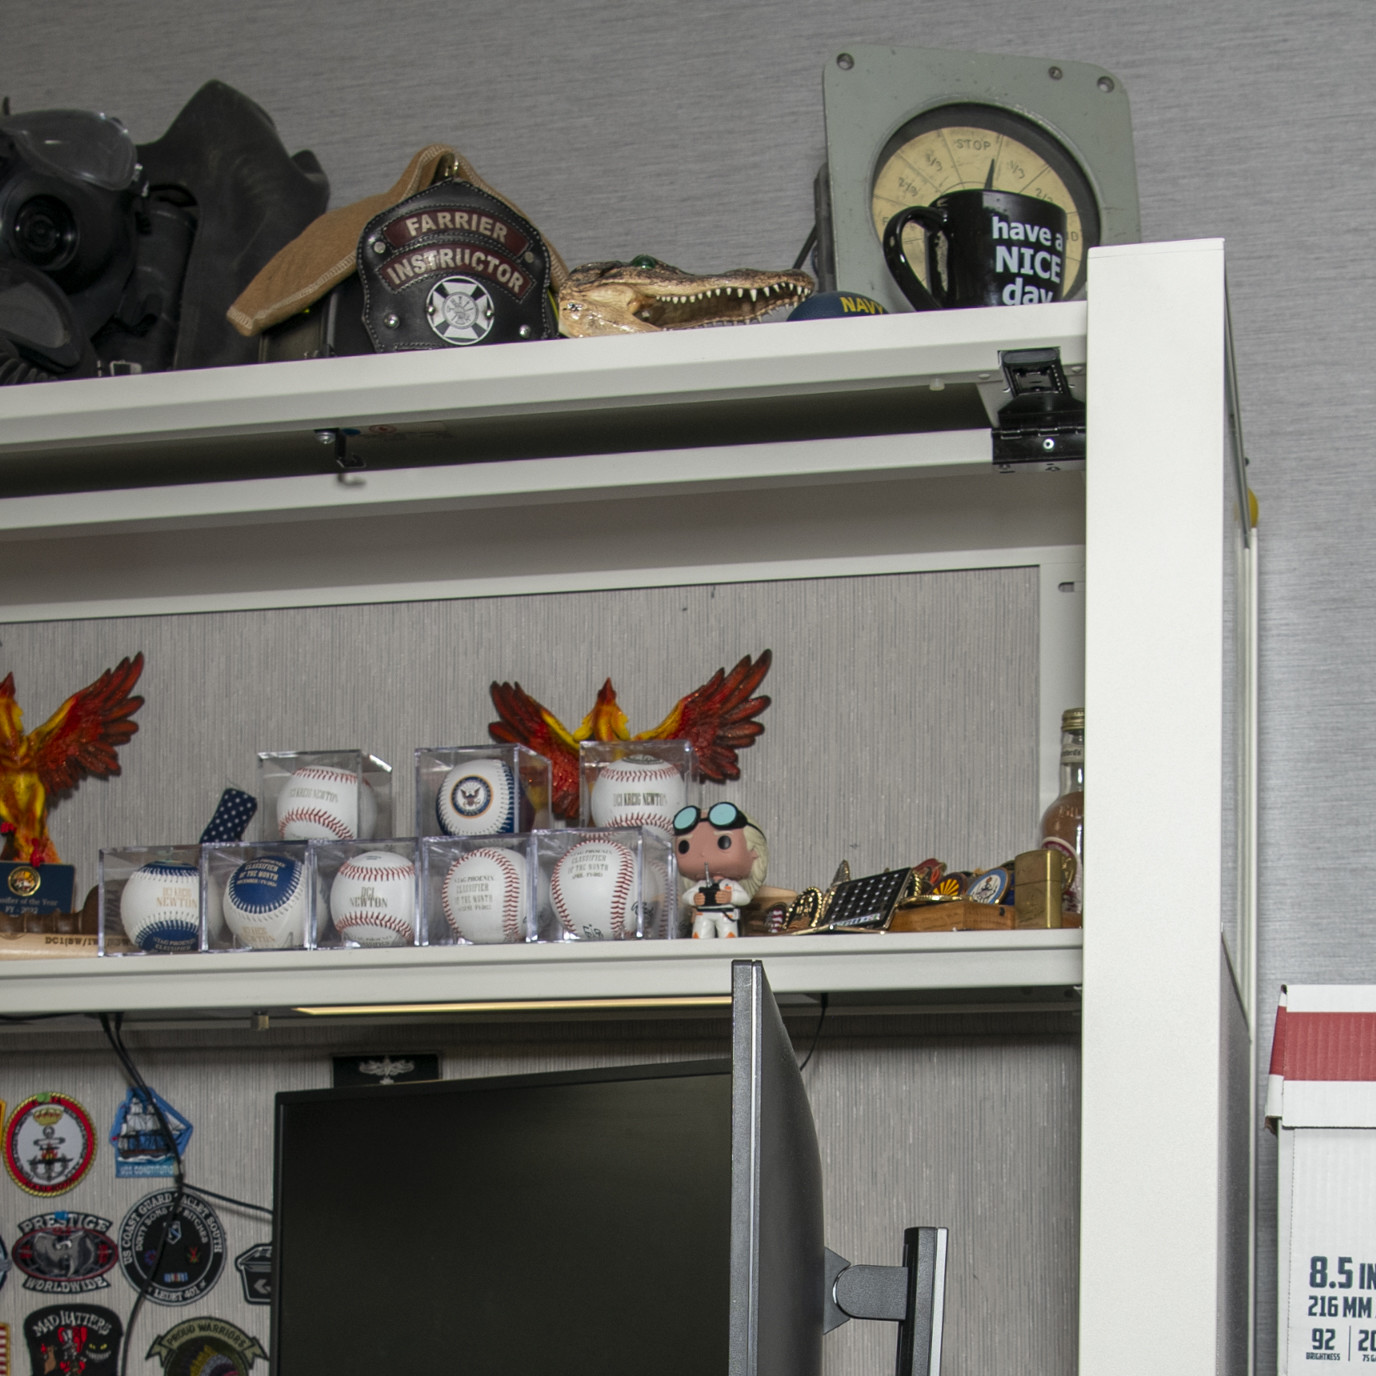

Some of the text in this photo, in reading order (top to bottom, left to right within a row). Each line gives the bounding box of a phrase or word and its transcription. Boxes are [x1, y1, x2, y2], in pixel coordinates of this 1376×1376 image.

[956, 139, 991, 151] STOP
[405, 212, 508, 243] FARRIER
[992, 216, 1052, 246] have
[1055, 234, 1063, 251] a
[387, 248, 524, 294] INSTRUCTOR
[995, 245, 1062, 284] NICE
[1002, 277, 1053, 306] day
[840, 297, 884, 315] NAVY
[350, 897, 388, 908] NEWTON
[21, 1213, 112, 1233] PRESTIGE
[122, 1193, 223, 1265] US COAST GUARD ACLET SOUTH
[135, 1226, 148, 1251] DIRTY
[183, 1210, 210, 1244] BITCHES
[25, 1276, 108, 1294] WORLDWIDE
[1309, 1256, 1353, 1290] 8.5
[184, 1286, 201, 1299] 401
[1308, 1296, 1339, 1317] 216
[1342, 1297, 1373, 1319] MM
[32, 1310, 113, 1338] MAD HATTERS
[166, 1323, 247, 1348] PROUD WARRIORS
[1311, 1328, 1336, 1350] 92
[1305, 1352, 1341, 1361] BRIGHTNESS
